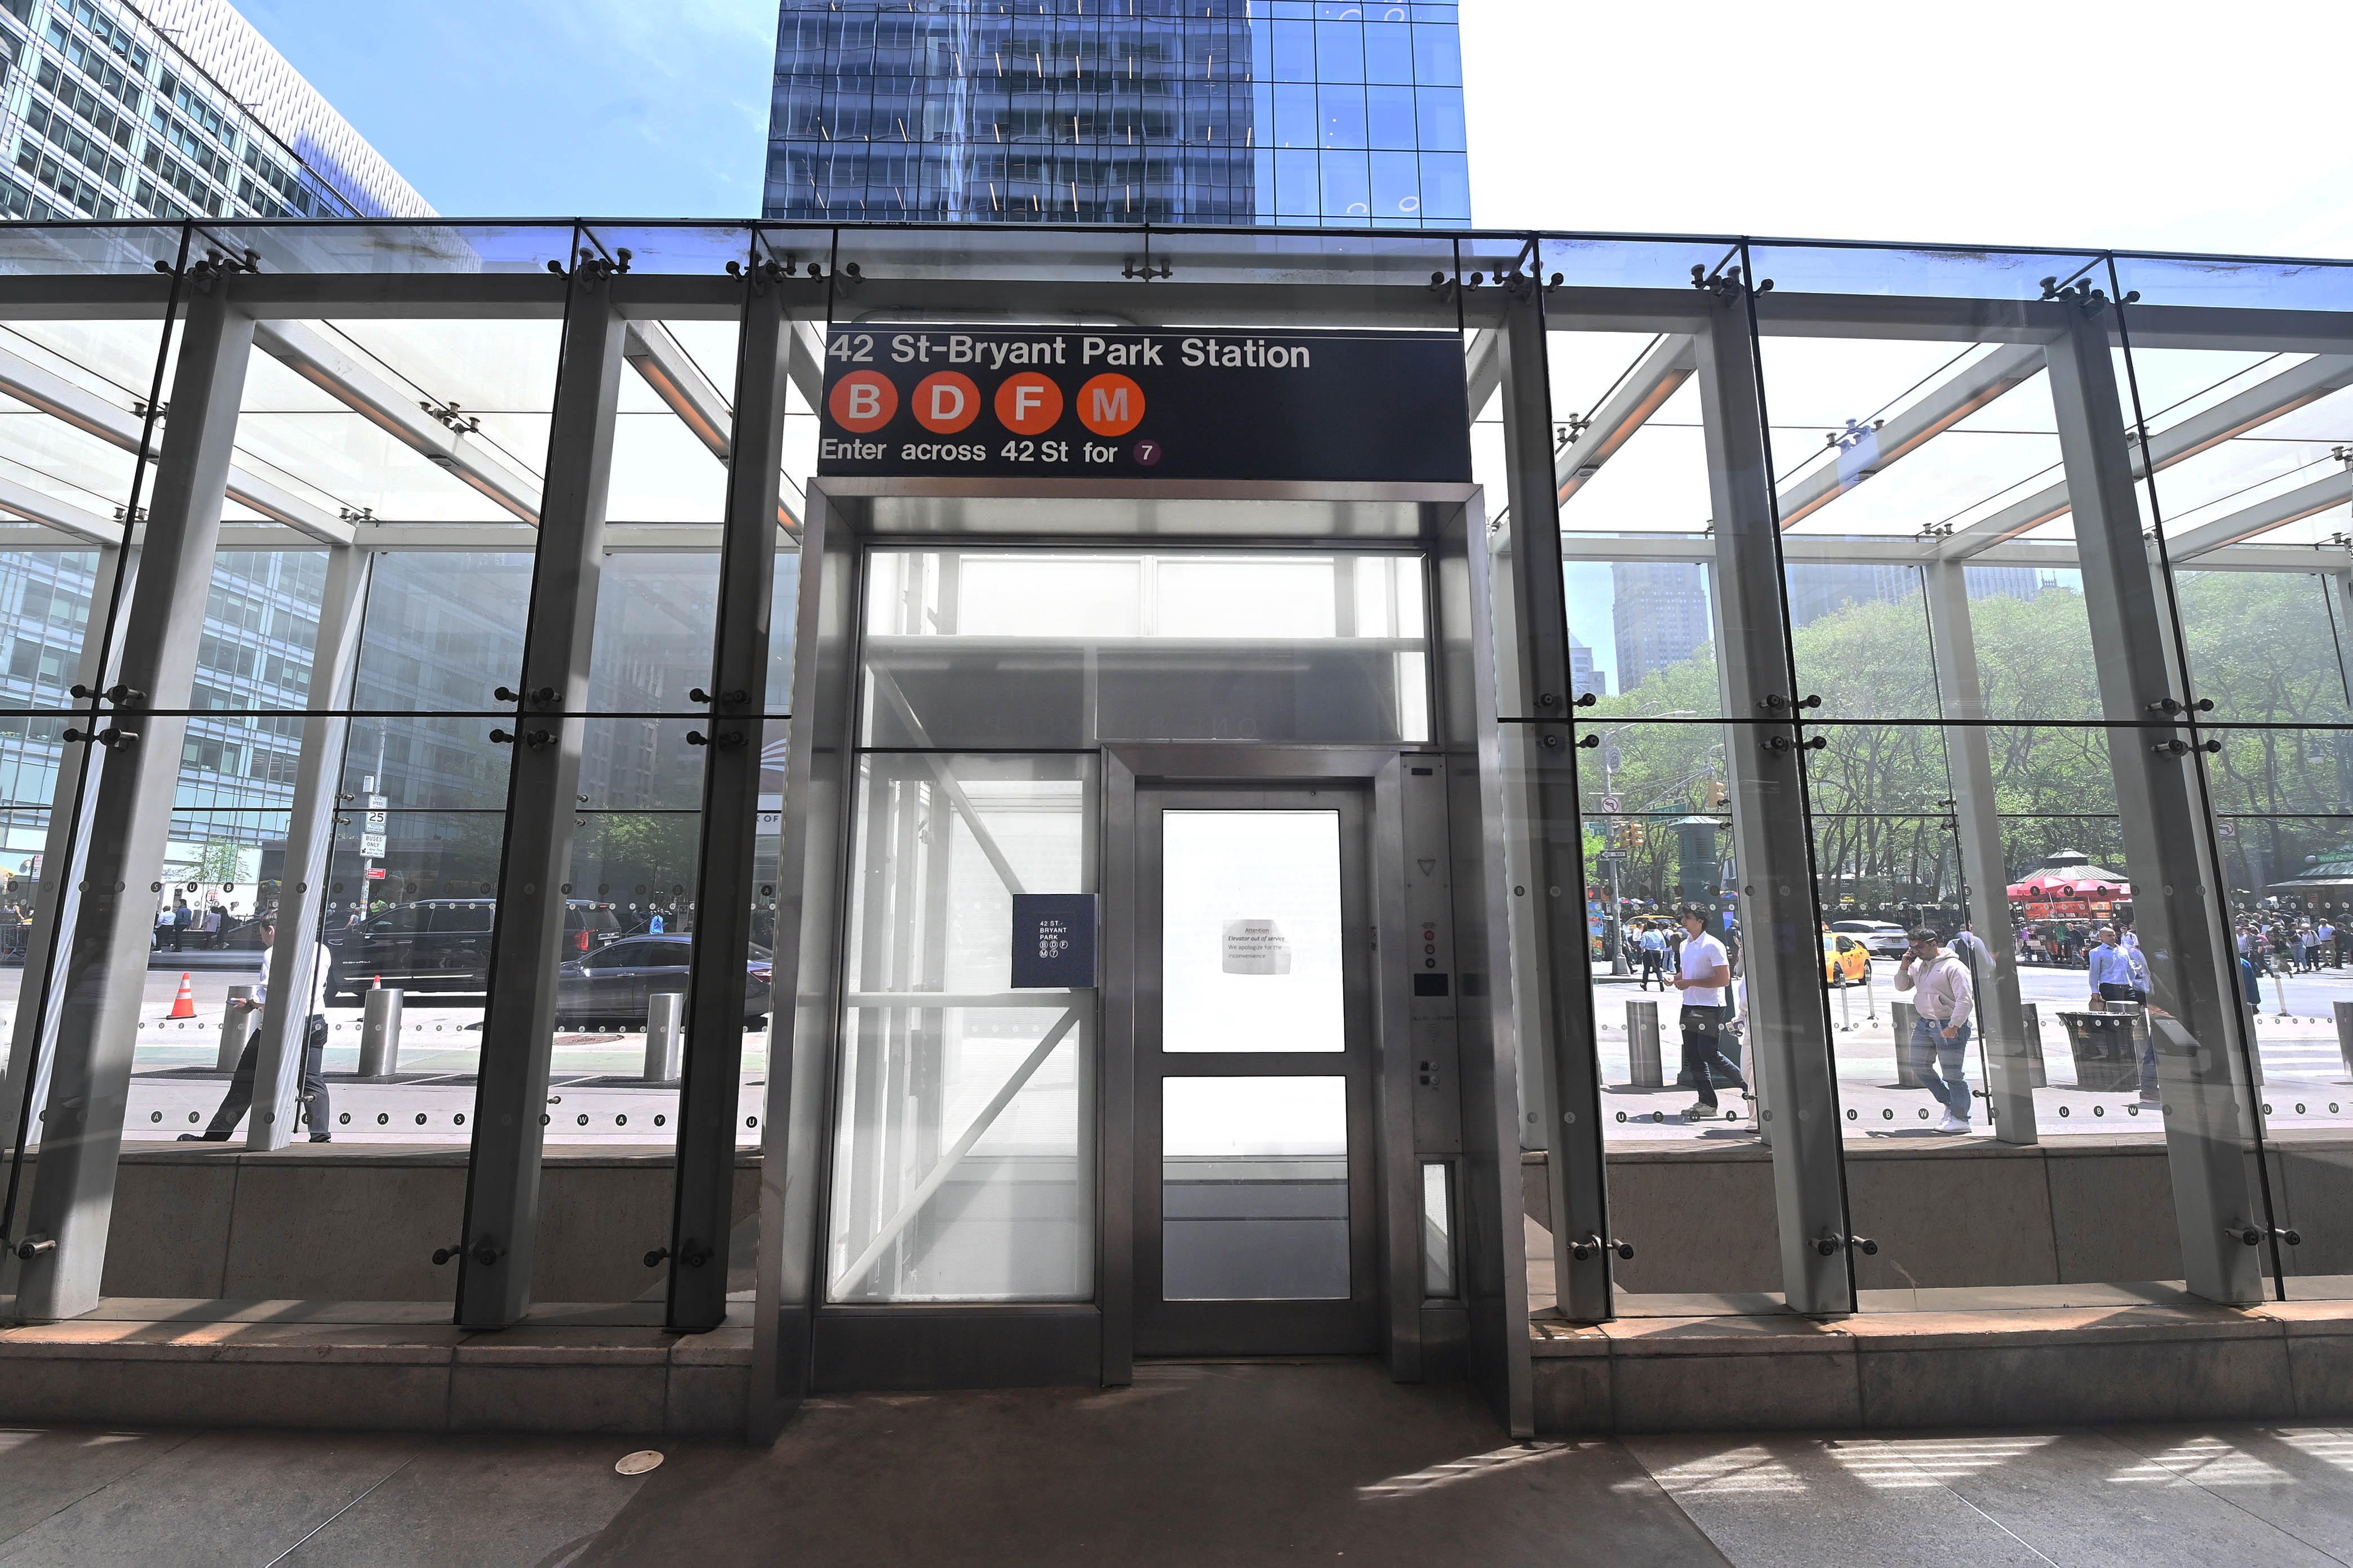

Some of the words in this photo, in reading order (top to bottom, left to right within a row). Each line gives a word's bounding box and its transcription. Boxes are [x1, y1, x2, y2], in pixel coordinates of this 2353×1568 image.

[828, 334, 874, 362] 42
[891, 334, 1065, 370] St-Bryant
[1082, 337, 1164, 365] Park
[1182, 338, 1311, 368] Station
[849, 384, 880, 419] B
[931, 385, 964, 419] D
[1015, 386, 1044, 420] F
[1092, 388, 1129, 421] M
[820, 438, 887, 460] Enter
[902, 443, 986, 461] across
[1001, 441, 1034, 462] 42
[1041, 441, 1068, 462] St
[1083, 442, 1118, 463] for
[1142, 445, 1153, 460] 7
[369, 812, 384, 822] 25
